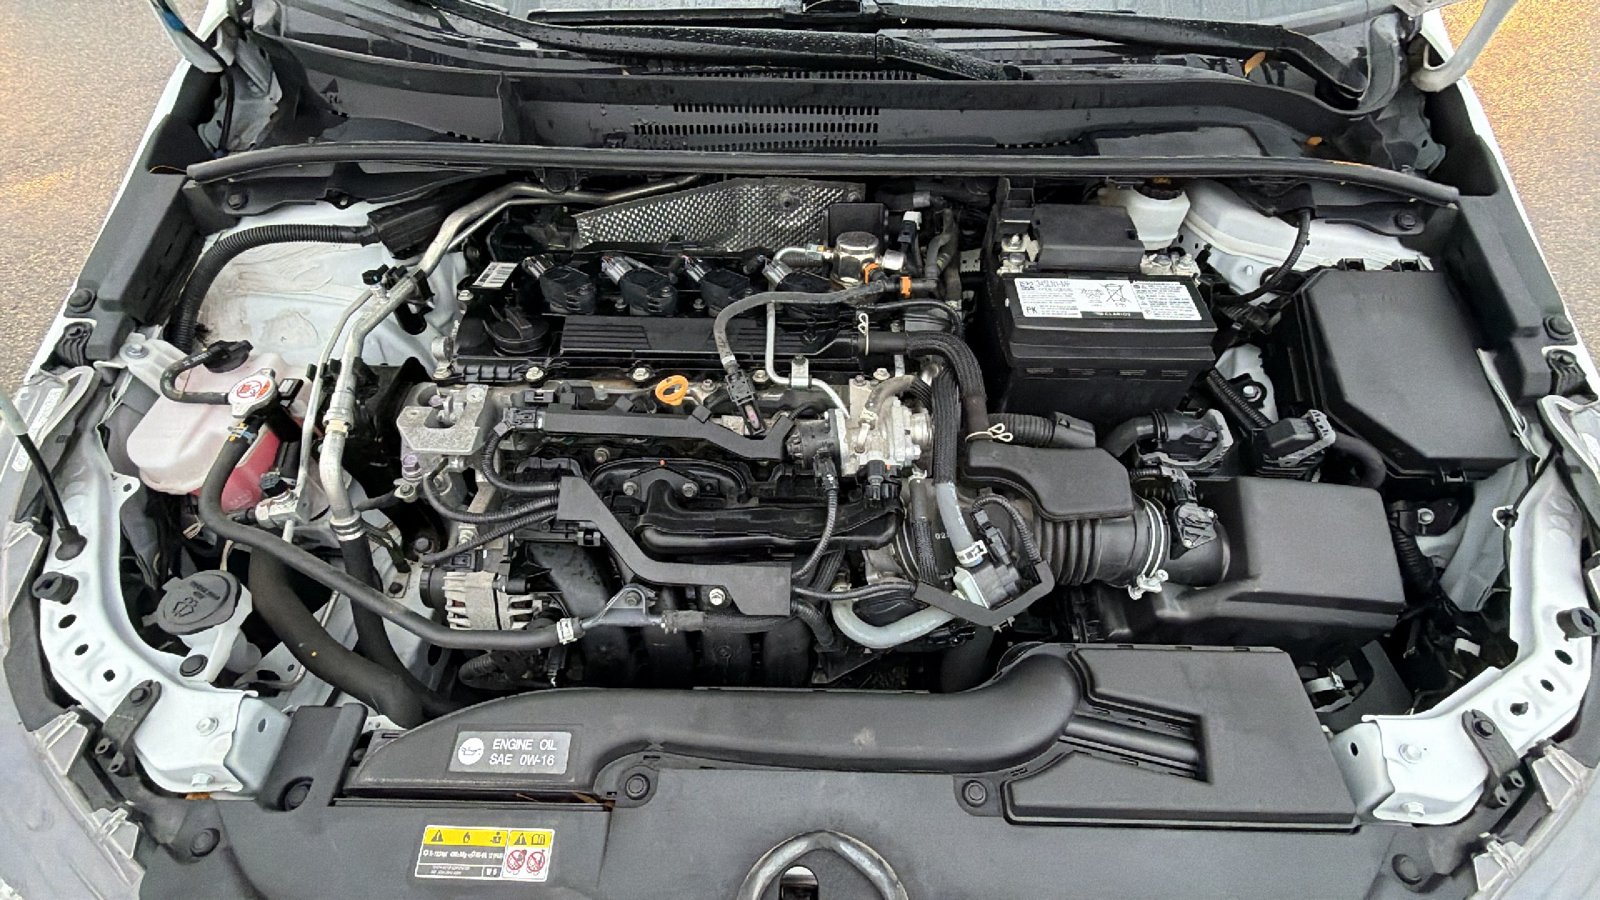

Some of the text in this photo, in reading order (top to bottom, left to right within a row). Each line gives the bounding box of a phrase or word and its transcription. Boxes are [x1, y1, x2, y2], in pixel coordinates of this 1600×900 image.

[492, 738, 558, 751] ENGINE OIL
[489, 753, 555, 766] SAE 0W-16
